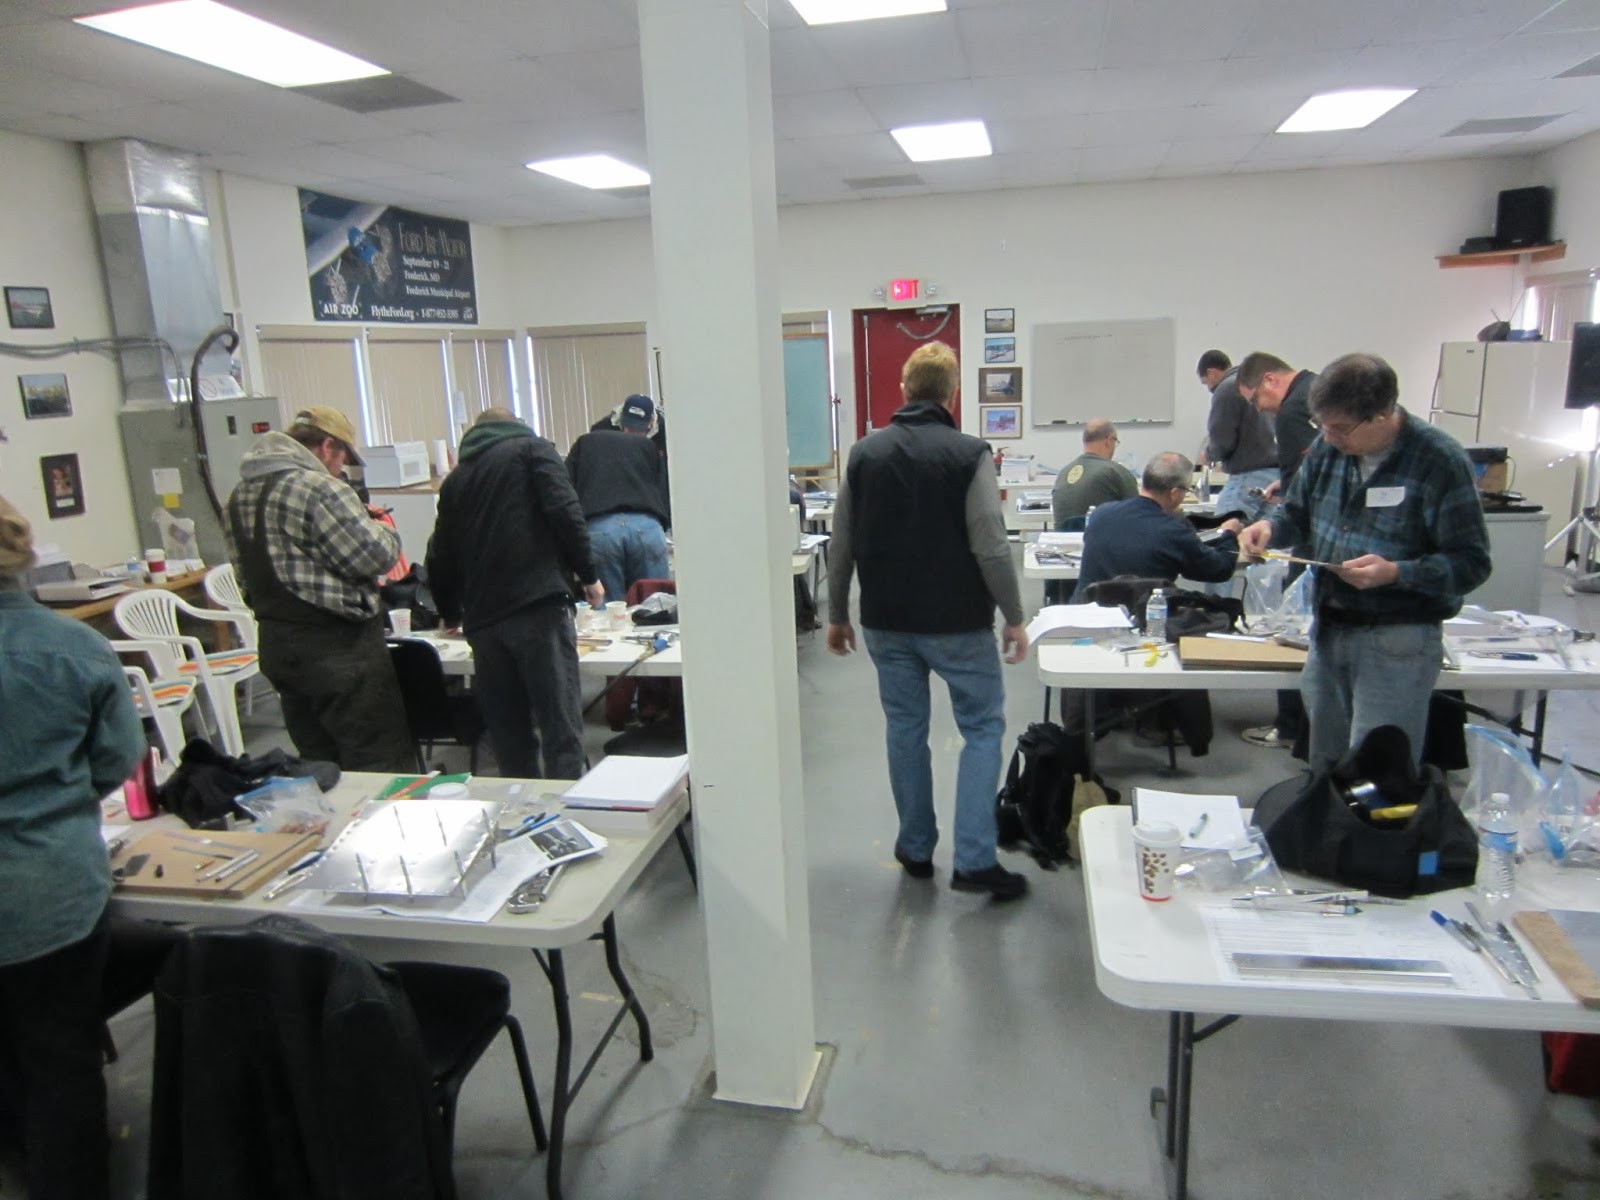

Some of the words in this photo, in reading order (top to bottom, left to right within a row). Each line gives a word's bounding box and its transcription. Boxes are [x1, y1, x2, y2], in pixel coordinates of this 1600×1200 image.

[402, 255, 432, 269] September
[891, 279, 919, 301] EXIT
[324, 303, 339, 315] AIR
[340, 303, 359, 316] ZOO
